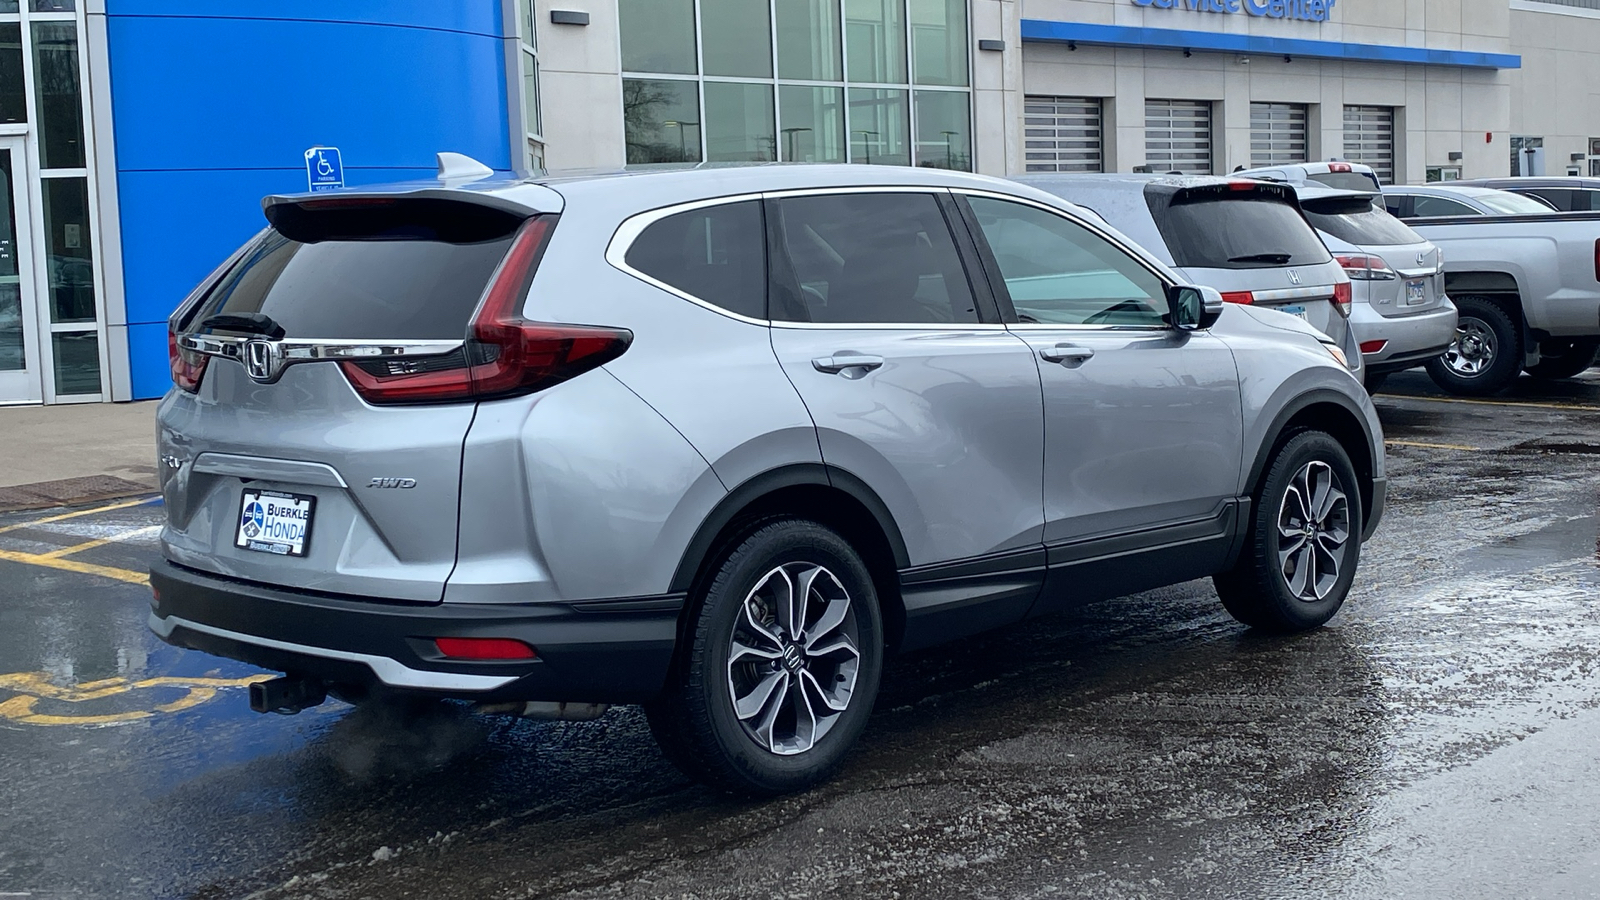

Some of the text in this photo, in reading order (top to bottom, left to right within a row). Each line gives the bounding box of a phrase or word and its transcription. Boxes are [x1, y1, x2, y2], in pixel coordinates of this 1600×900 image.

[366, 477, 417, 489] AWD
[267, 503, 309, 520] BUERKLE
[263, 516, 304, 541] HONDA
